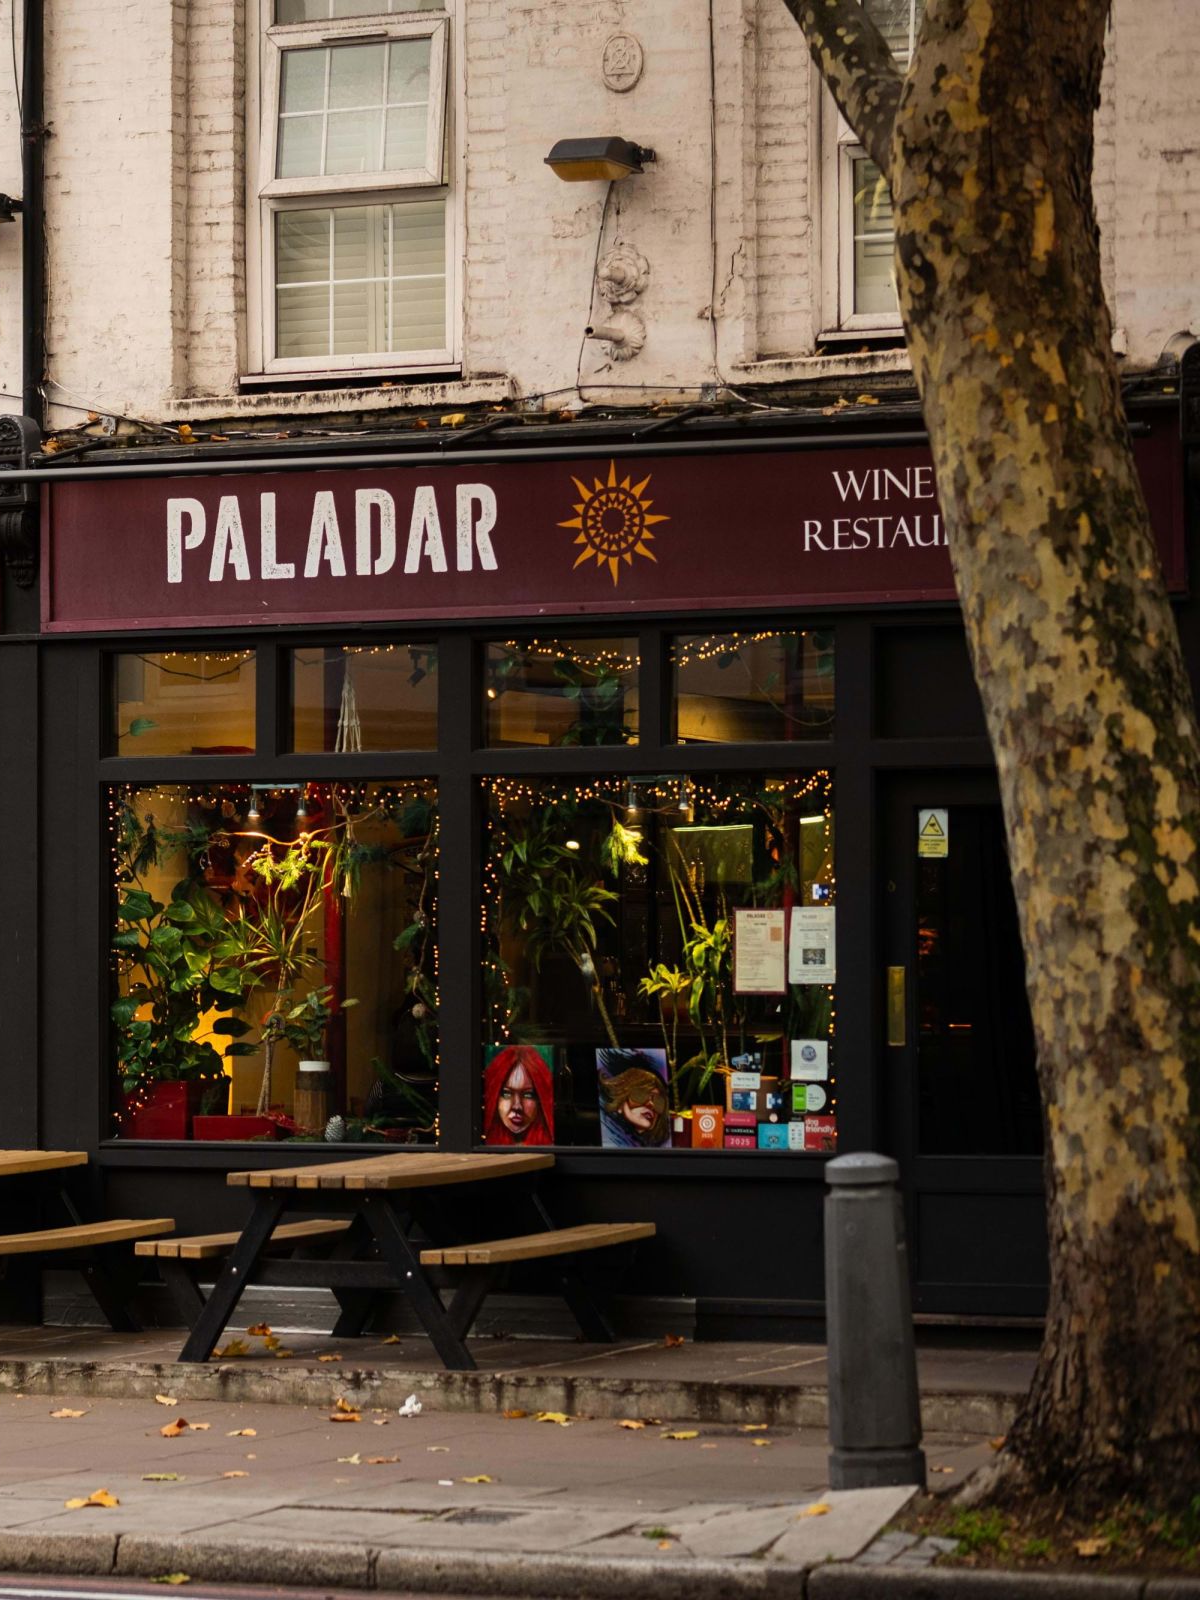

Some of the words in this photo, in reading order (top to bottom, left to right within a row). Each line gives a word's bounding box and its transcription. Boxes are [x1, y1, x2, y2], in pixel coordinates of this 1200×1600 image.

[832, 466, 935, 502] WINE
[167, 483, 498, 583] PALADAR
[803, 514, 949, 551] RESTAU
[730, 1137, 750, 1146] 2025
[805, 1124, 835, 1135] friendly
